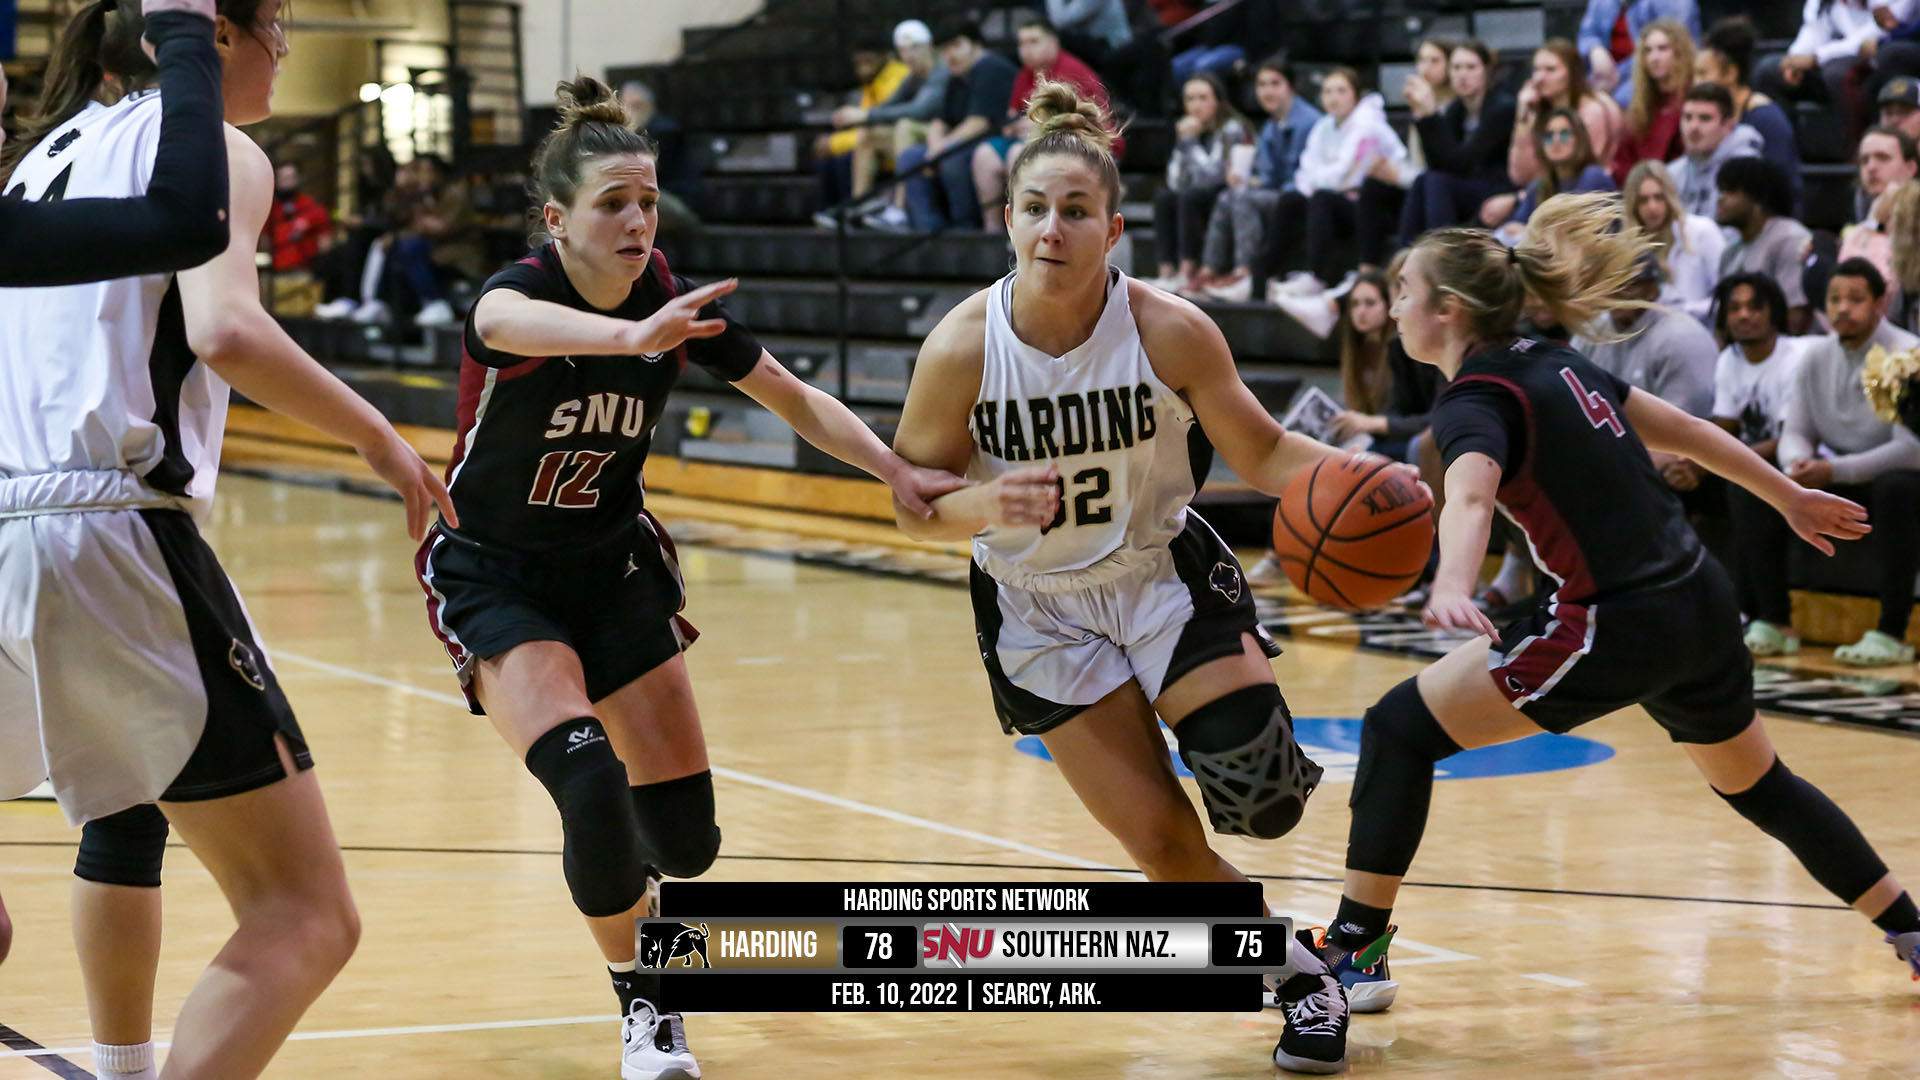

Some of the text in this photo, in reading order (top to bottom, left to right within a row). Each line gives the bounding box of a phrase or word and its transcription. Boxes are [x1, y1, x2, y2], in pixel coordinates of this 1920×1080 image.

[544, 392, 644, 439] SNU
[974, 382, 1157, 462] HARDING
[1559, 366, 1626, 438] 4
[527, 450, 616, 509] 12
